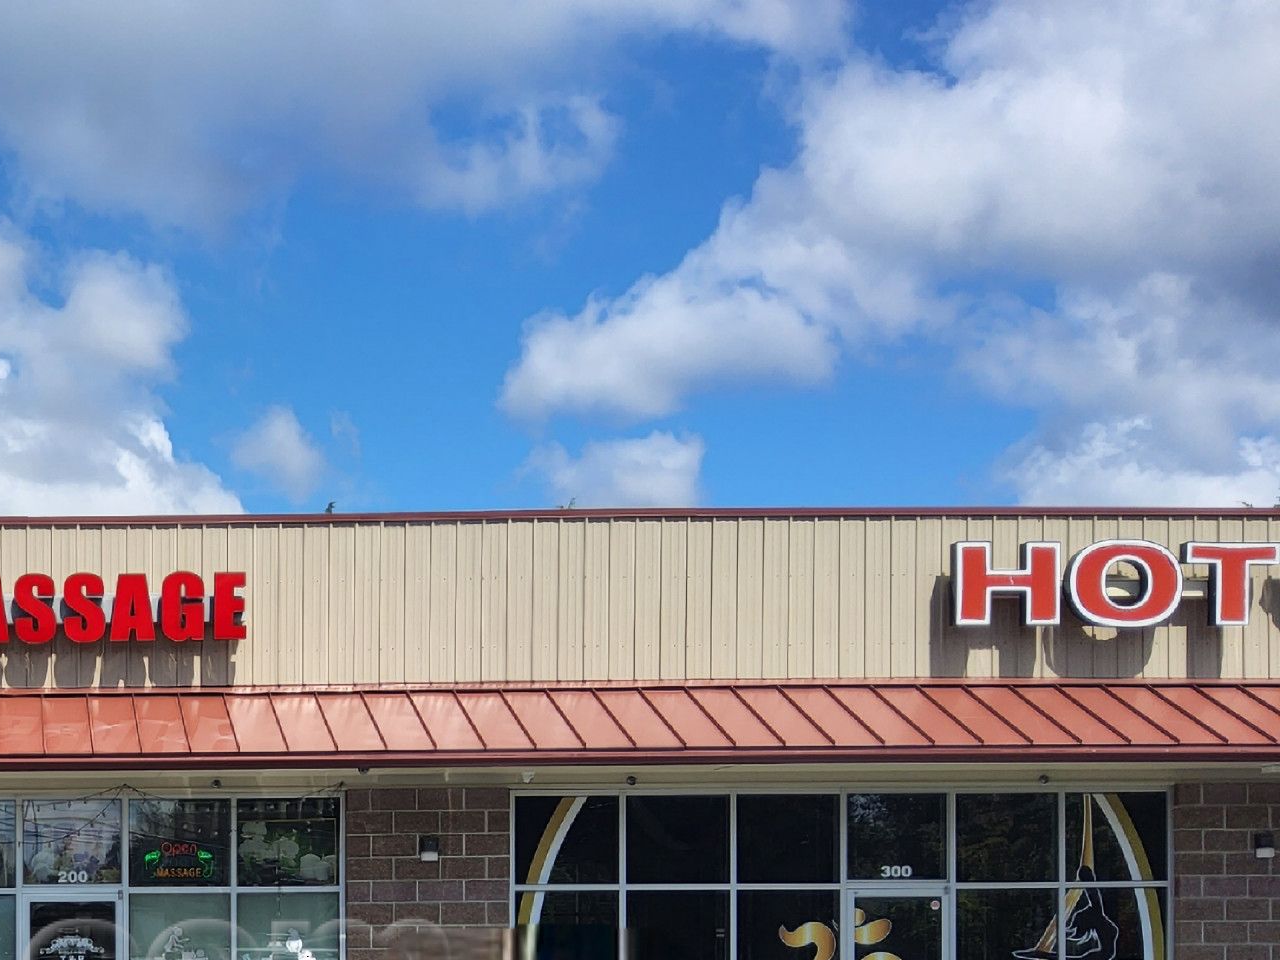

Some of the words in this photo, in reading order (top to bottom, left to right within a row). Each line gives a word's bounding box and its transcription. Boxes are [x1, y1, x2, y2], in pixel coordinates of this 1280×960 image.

[950, 539, 1280, 627] HOT
[57, 870, 89, 884] 200
[156, 867, 202, 879] MASSAGE
[880, 865, 913, 878] 300
